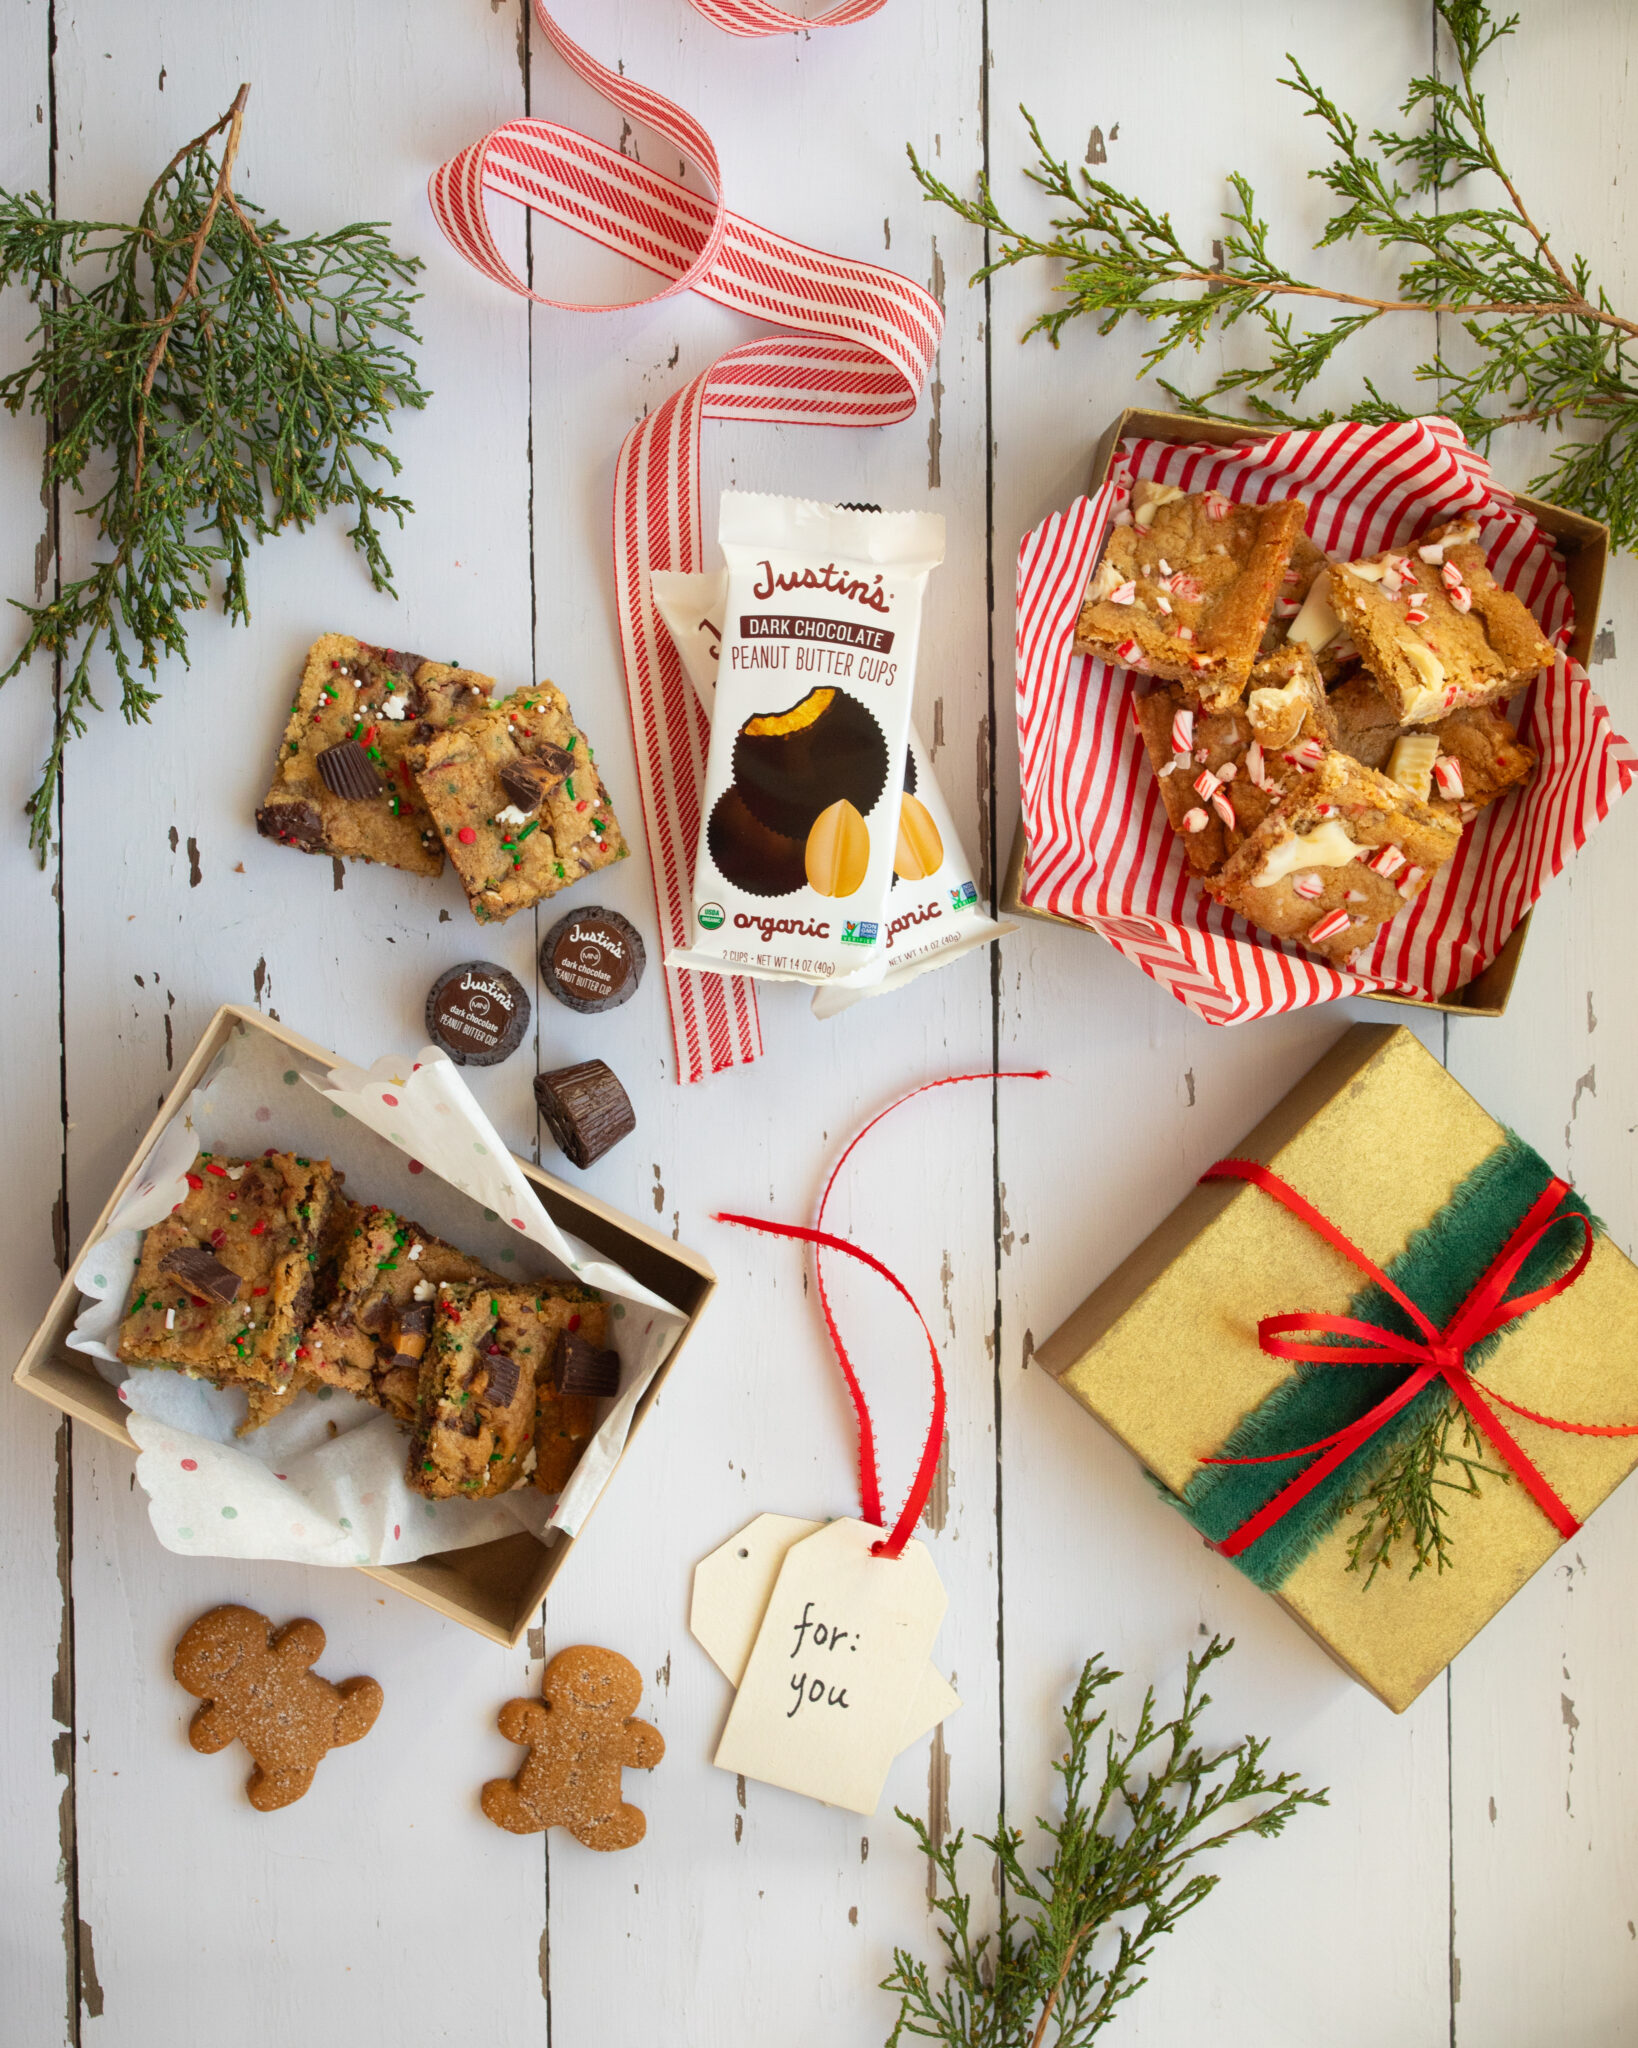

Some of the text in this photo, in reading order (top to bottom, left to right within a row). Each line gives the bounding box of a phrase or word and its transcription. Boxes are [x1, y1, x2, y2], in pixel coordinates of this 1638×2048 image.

[753, 560, 890, 613] Justin's
[750, 619, 884, 648] DARK CHOCOLATE
[731, 646, 790, 670] PEANUT
[796, 647, 853, 677] BUTTER
[858, 656, 897, 686] CUPS
[704, 908, 720, 916] USDA
[569, 924, 622, 959] Justin's
[733, 913, 830, 942] organic
[561, 958, 612, 981] dark chocolate
[582, 952, 599, 960] MINI
[722, 949, 728, 960] 2
[729, 950, 749, 963] CUPS
[756, 954, 772, 966] NET
[774, 955, 788, 969] WT
[801, 959, 813, 972] OZ
[814, 960, 836, 977] (40g)
[888, 955, 903, 967] NET
[904, 949, 917, 960] WT
[460, 972, 512, 1011] Justin's
[554, 967, 612, 995] PEANUT BUTTER CUP
[449, 1005, 499, 1033] dark chocolate
[471, 1000, 488, 1010] MINI
[439, 1013, 498, 1047] PEANUT BUTTER CUP
[790, 1602, 860, 1658] for:
[786, 1672, 849, 1718] you
